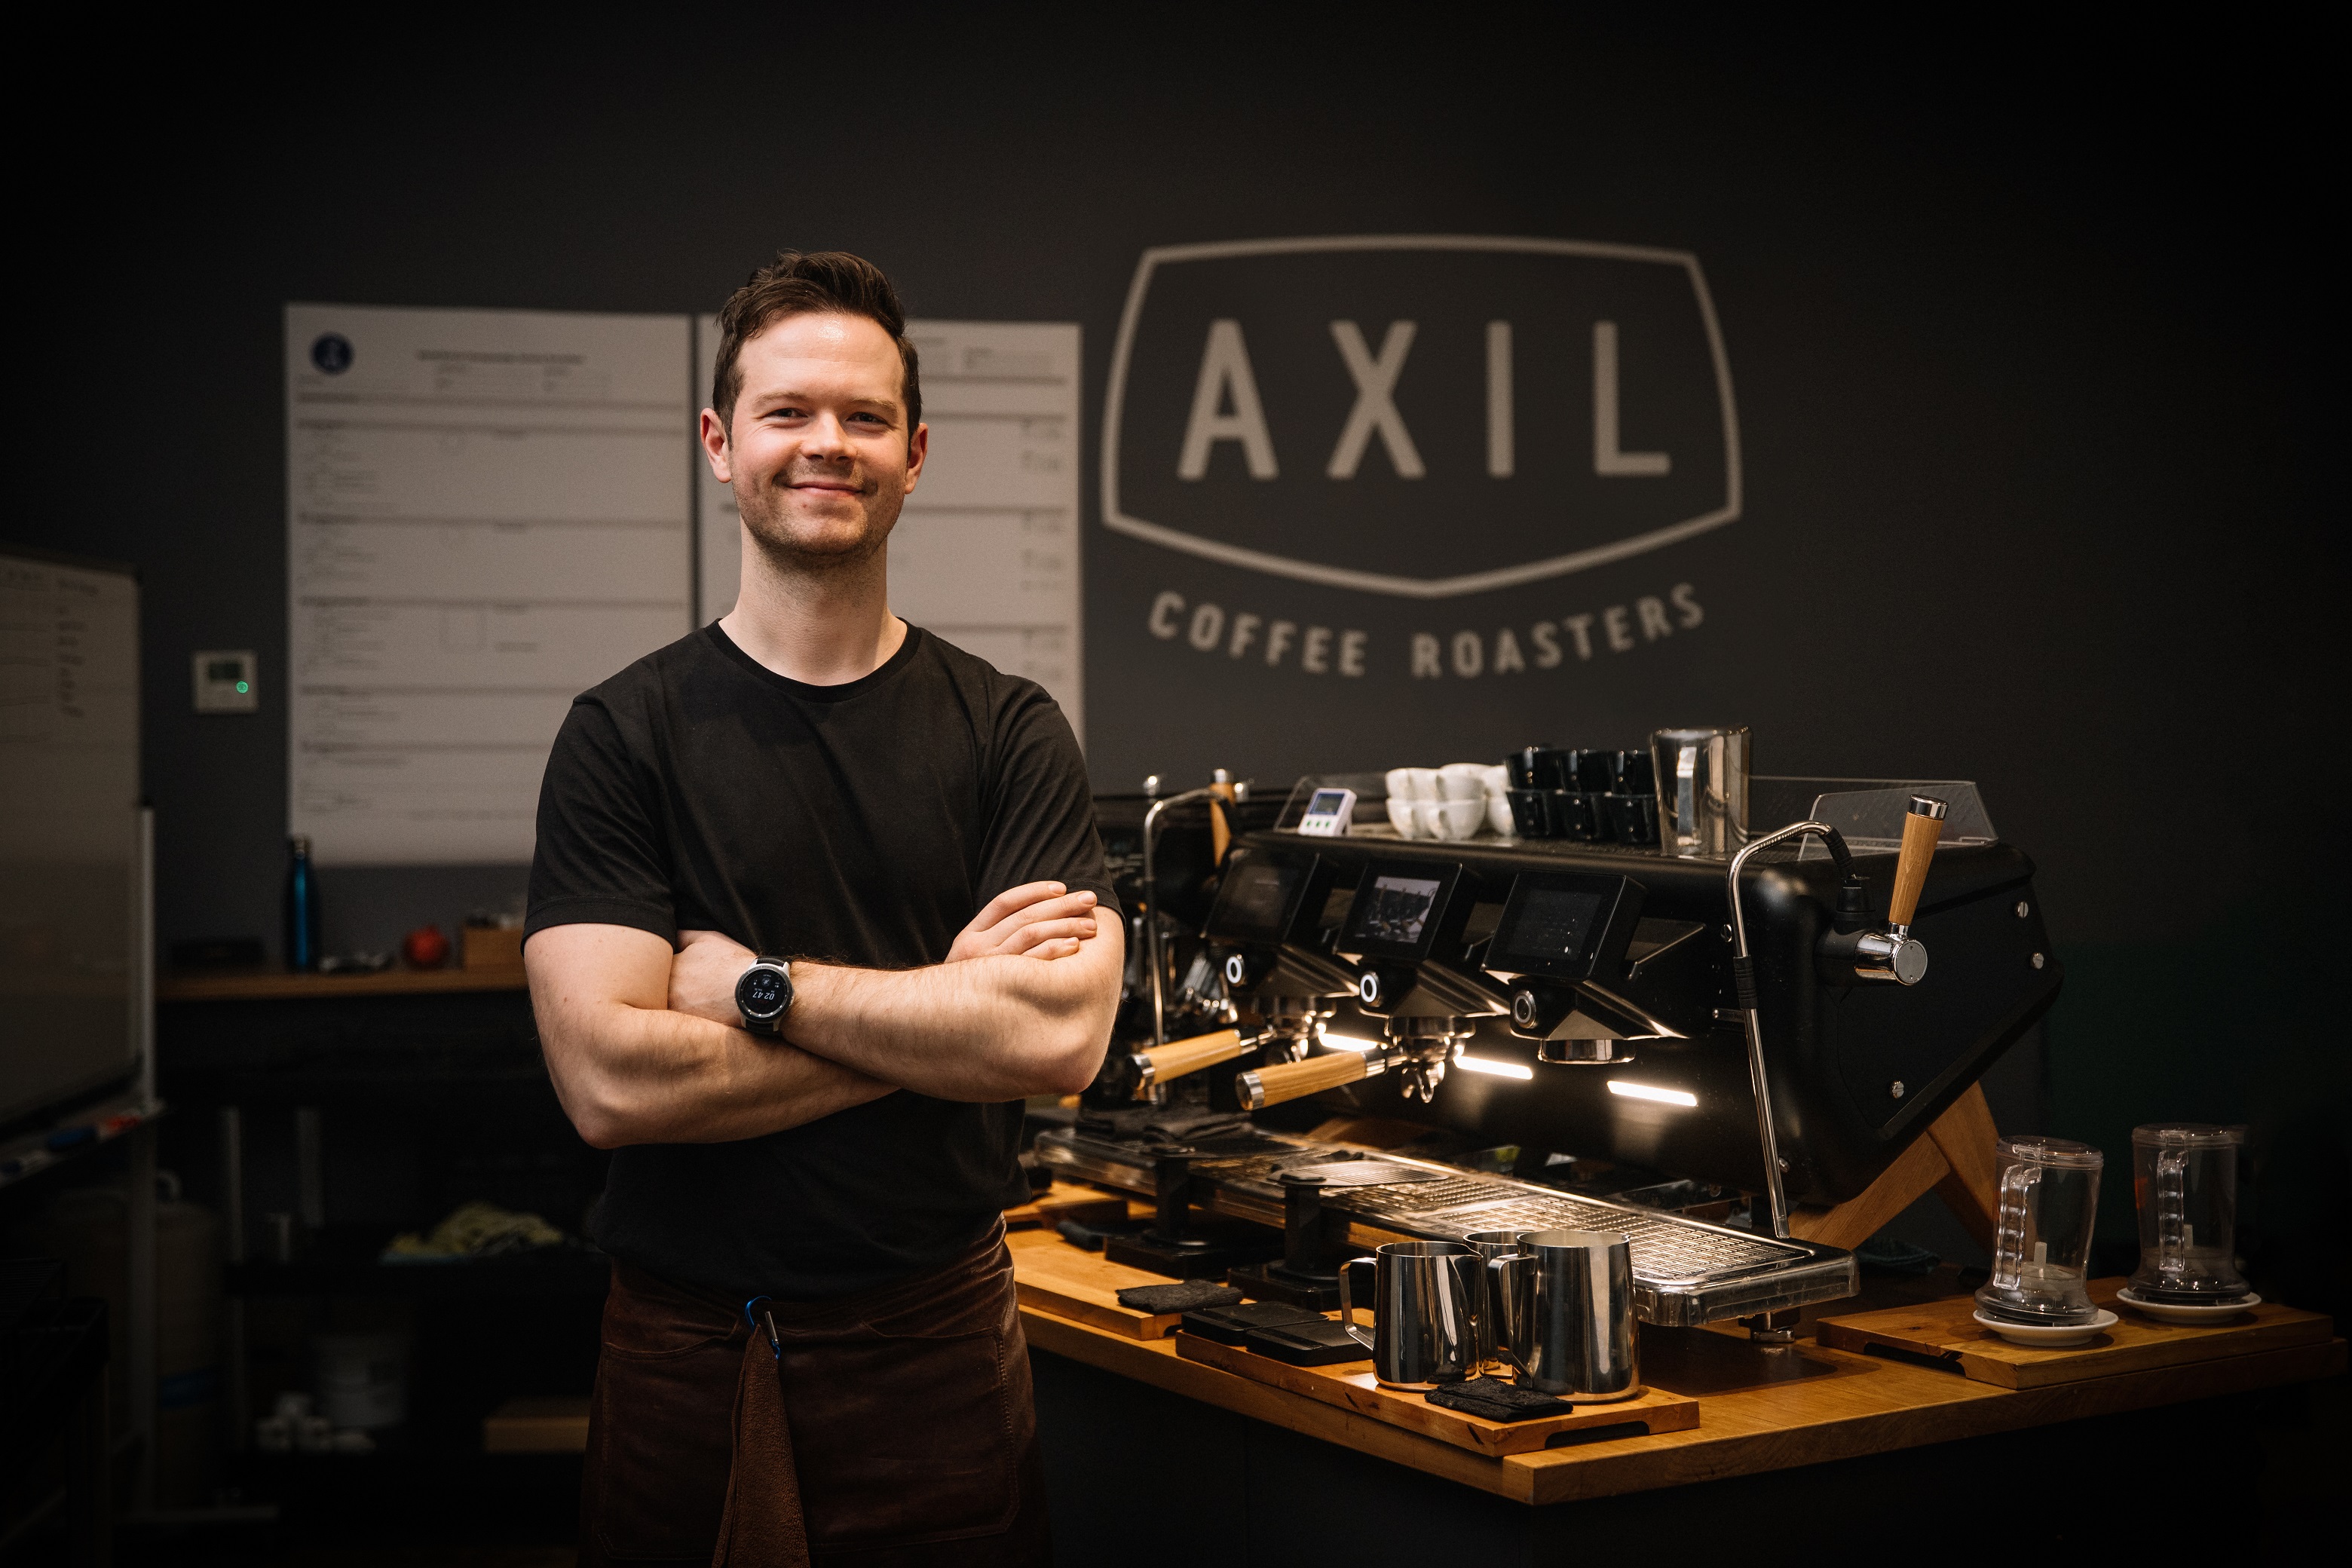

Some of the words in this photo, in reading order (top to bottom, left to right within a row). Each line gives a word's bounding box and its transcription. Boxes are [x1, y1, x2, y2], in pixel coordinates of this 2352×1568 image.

[1178, 320, 1670, 481] AXIL
[1148, 590, 1366, 678] COFFEE
[1411, 585, 1701, 678] ROASTERS
